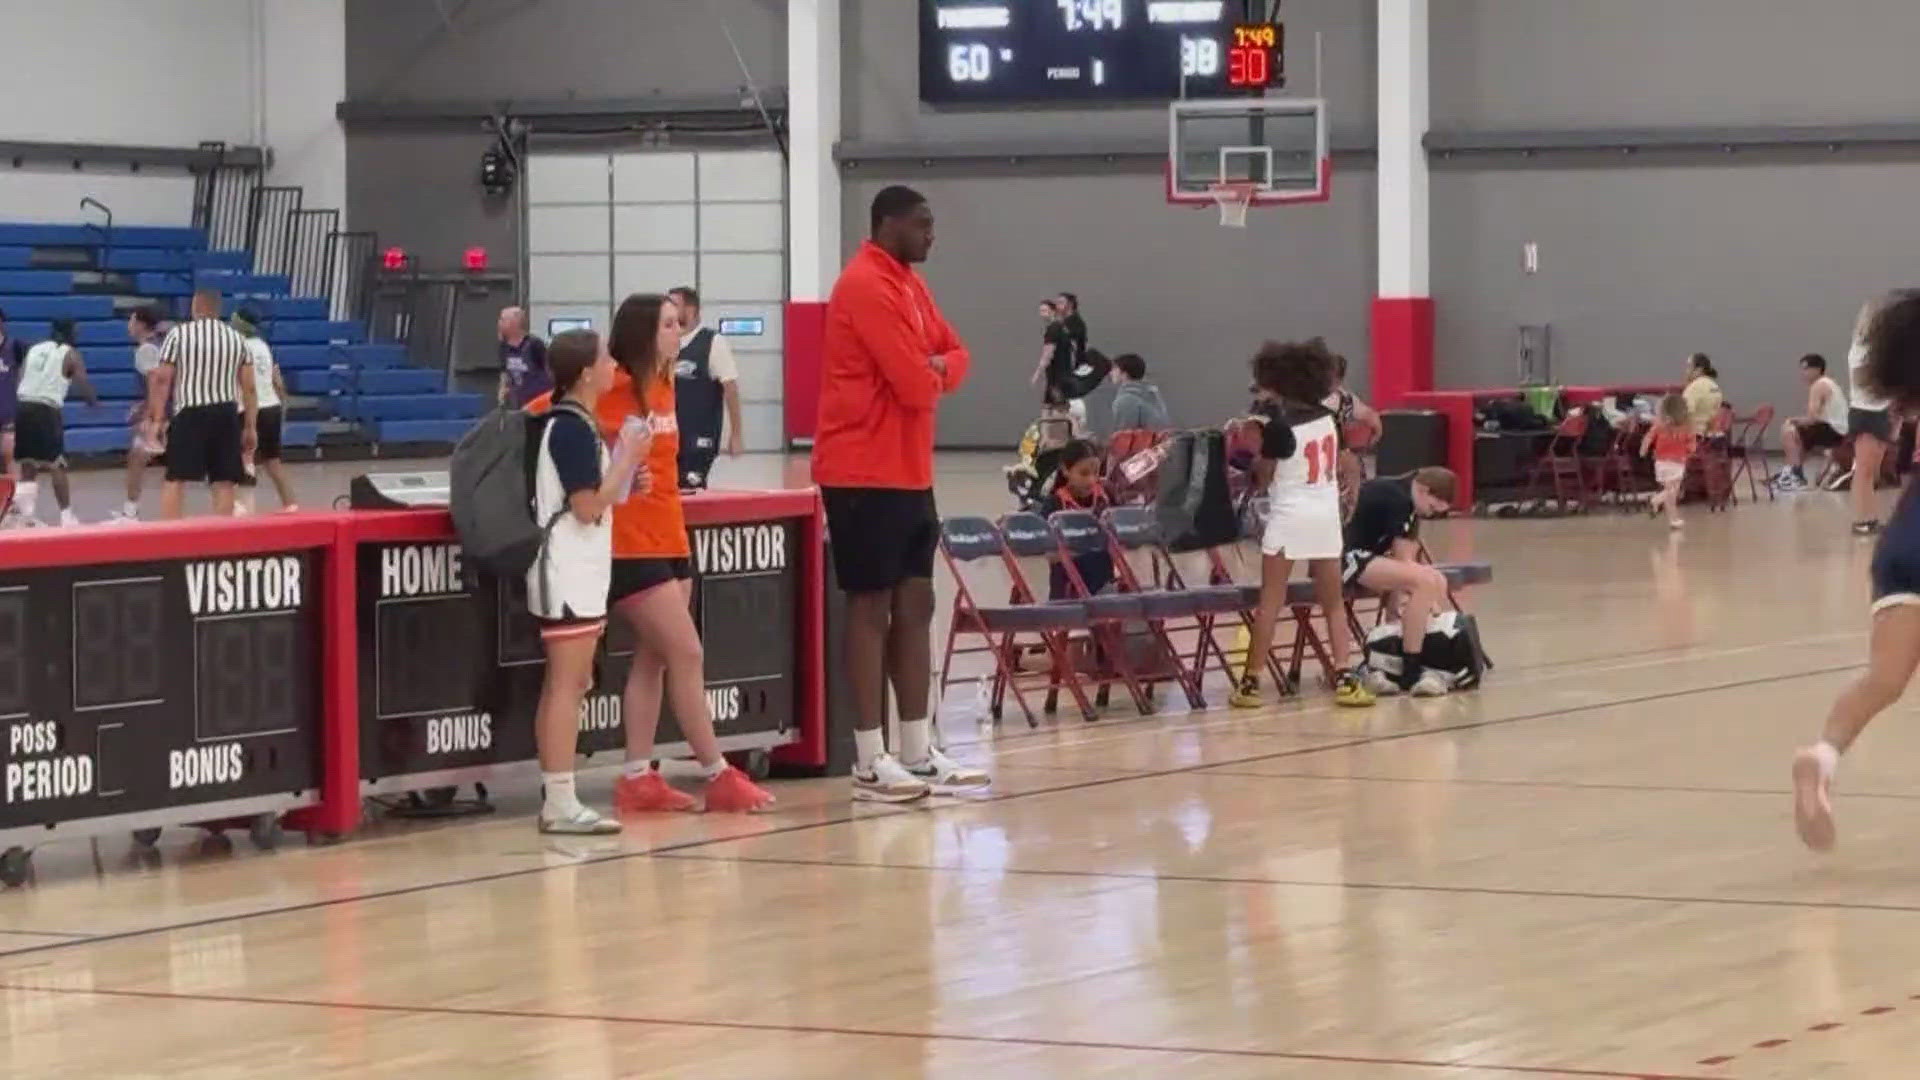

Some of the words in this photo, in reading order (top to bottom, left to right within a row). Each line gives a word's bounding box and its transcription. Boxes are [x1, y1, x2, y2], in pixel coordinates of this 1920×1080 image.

[1058, 0, 1122, 31] 7:49
[1234, 26, 1275, 47] 7:49
[949, 44, 990, 81] 60
[1230, 48, 1265, 84] 30
[1304, 434, 1334, 484] 11
[694, 525, 785, 573] VISITOR
[185, 557, 302, 615] VISITOR
[381, 544, 464, 597] HOME
[578, 694, 622, 731] RIOD
[704, 686, 739, 721] NUS
[10, 720, 57, 756] POSS
[426, 714, 492, 754] BONUS
[6, 754, 94, 803] PERIOD
[169, 742, 244, 789] BONUS
